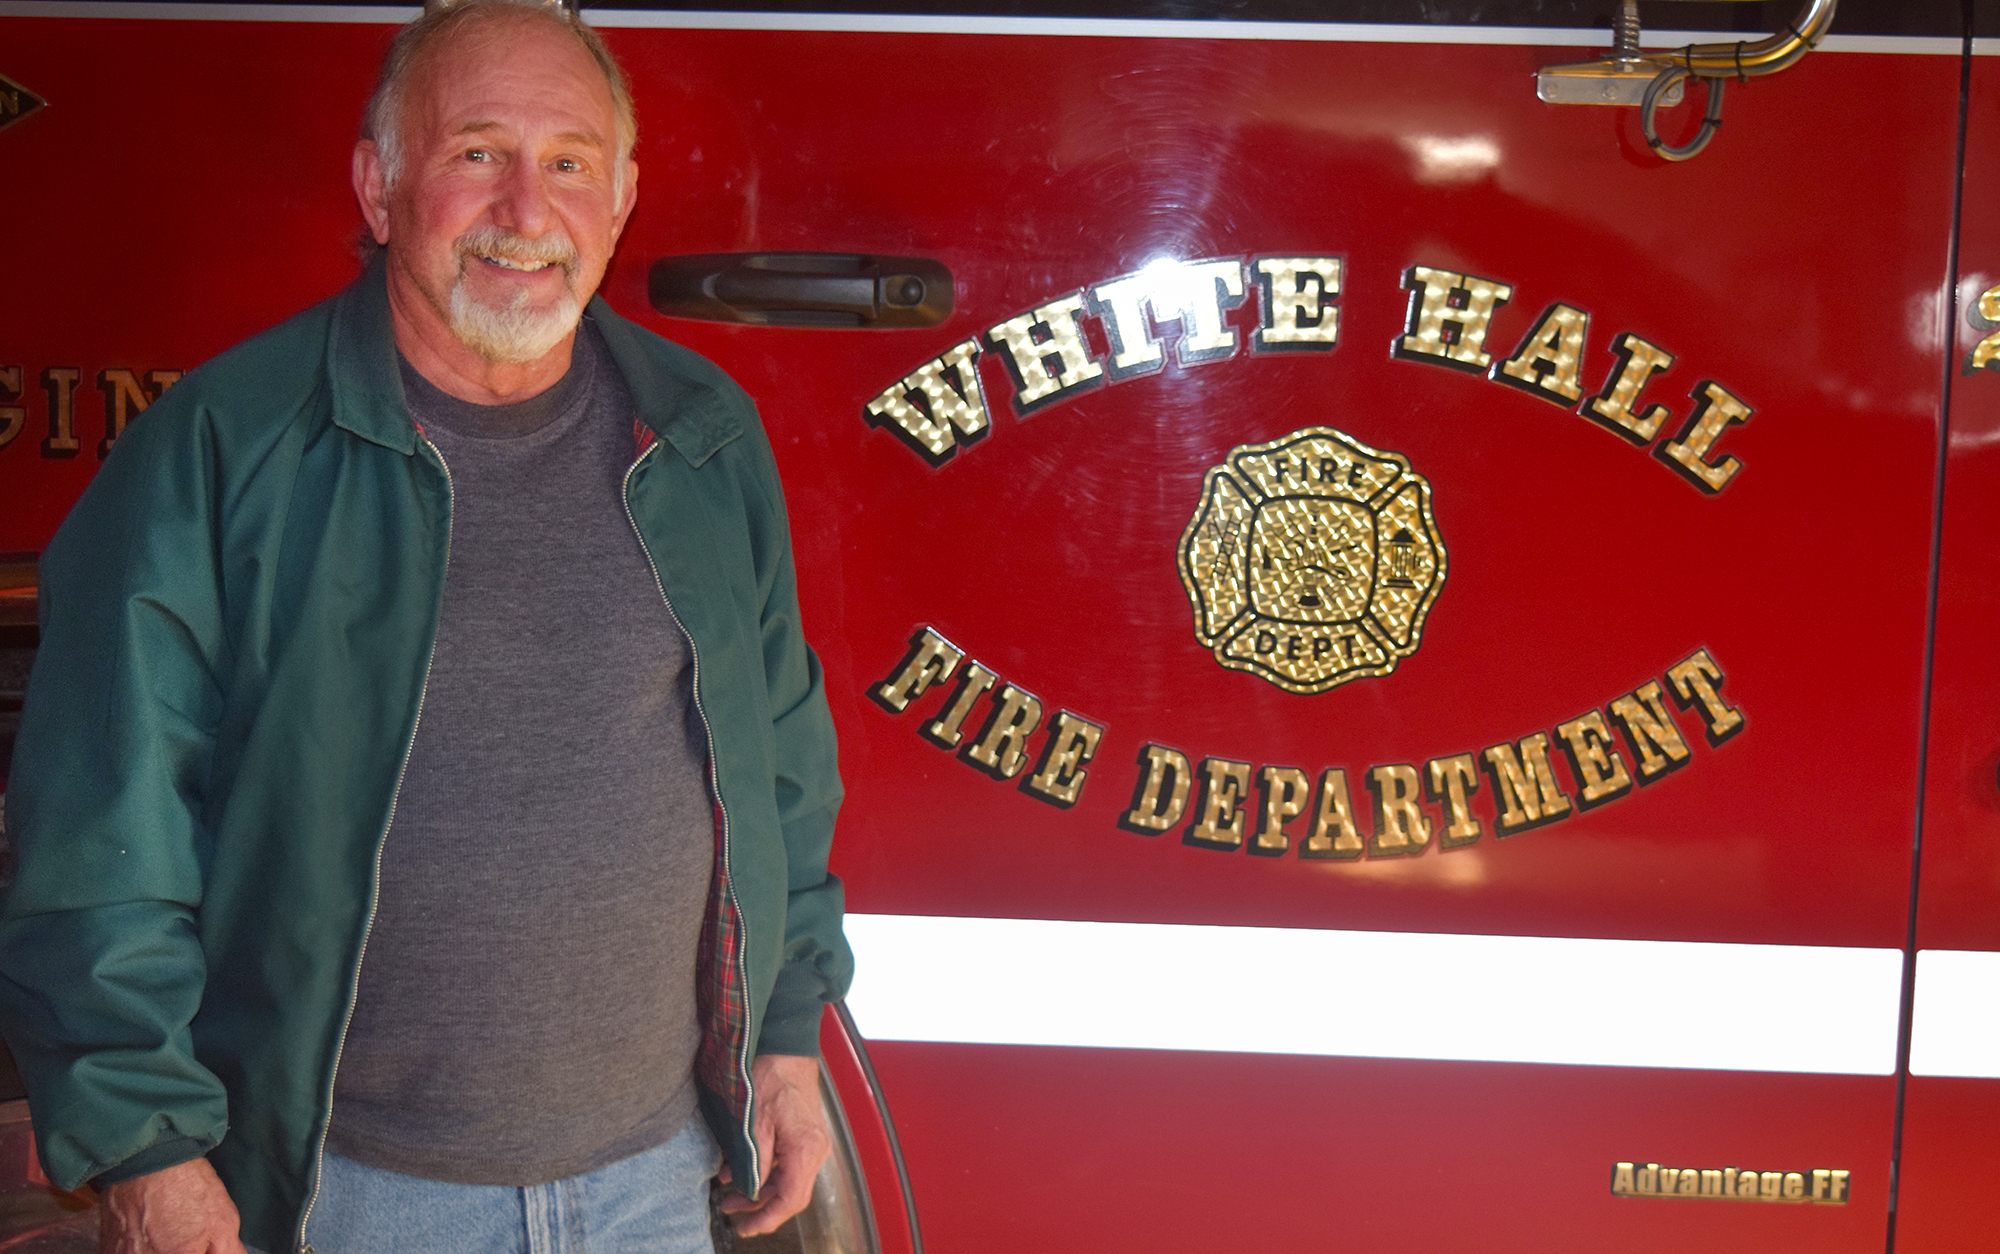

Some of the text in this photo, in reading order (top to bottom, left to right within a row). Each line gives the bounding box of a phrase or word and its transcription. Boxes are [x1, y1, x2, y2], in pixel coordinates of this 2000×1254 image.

[864, 256, 1343, 469] WHITE
[1390, 265, 1757, 495] HALL
[1275, 457, 1366, 489] FIRE
[1254, 629, 1367, 662] DEPT.
[865, 625, 1747, 859] FIRE DEPARTMENT
[1612, 1162, 1850, 1205] Advantage FF
